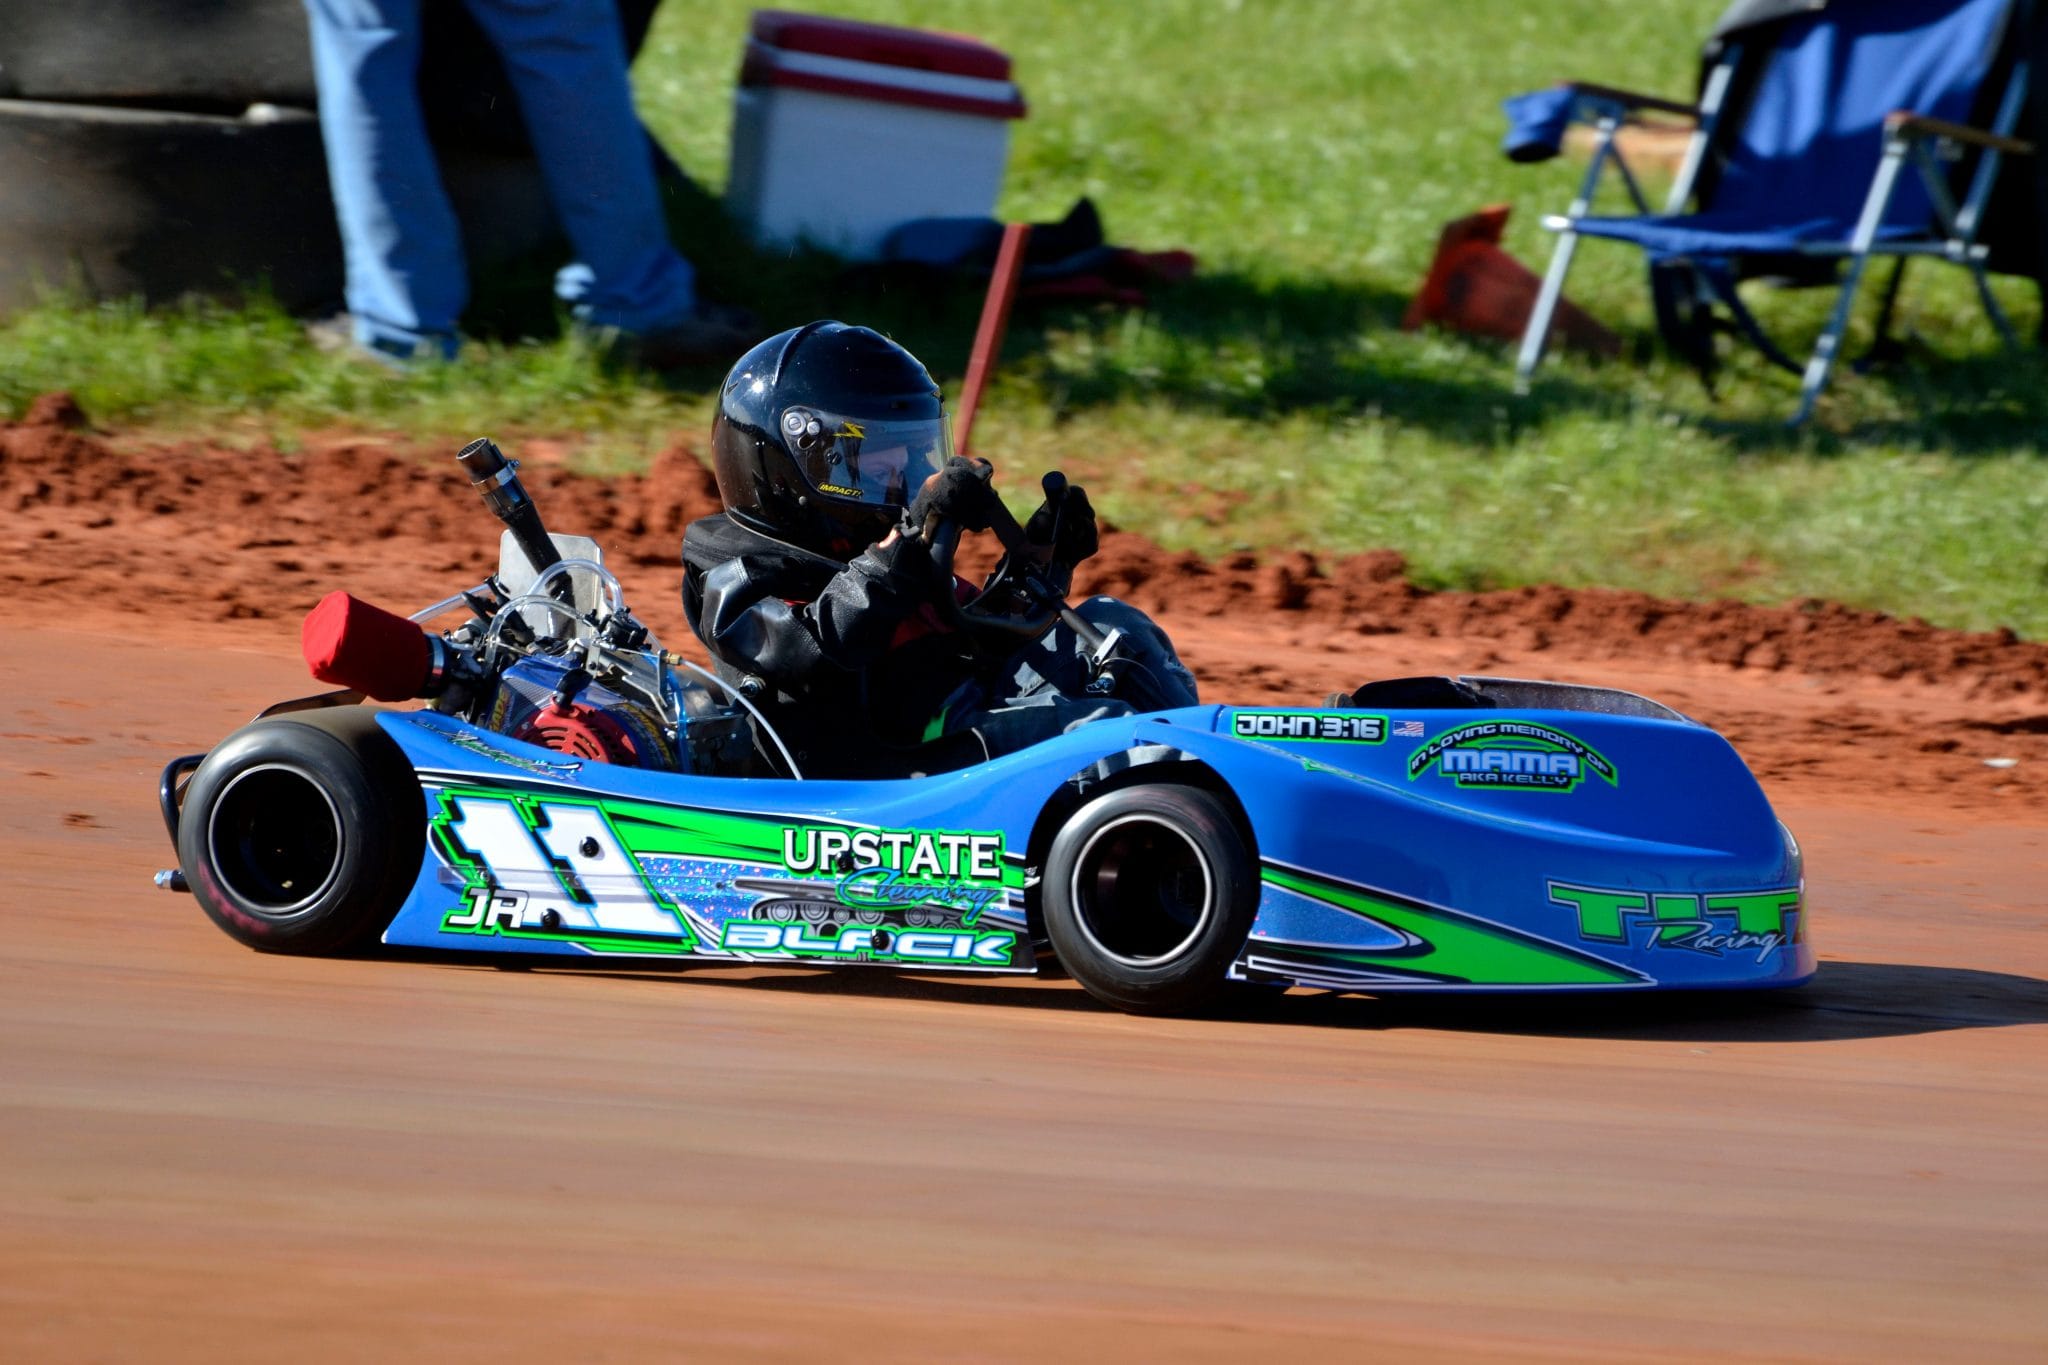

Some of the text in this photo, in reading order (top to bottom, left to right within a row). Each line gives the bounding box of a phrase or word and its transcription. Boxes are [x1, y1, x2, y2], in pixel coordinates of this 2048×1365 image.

[1236, 714, 1381, 739] JOHN 3:16
[1411, 723, 1610, 773] IN LOVING MEMORY OF
[1442, 750, 1580, 776] MAMA
[1459, 772, 1568, 785] AKA KELLY
[448, 796, 690, 938] 11
[783, 828, 1001, 878] UPSTATE
[447, 887, 530, 929] JR
[838, 865, 1000, 922] Cleaning
[723, 925, 1014, 961] BLACK
[1635, 920, 1787, 963] Racing
